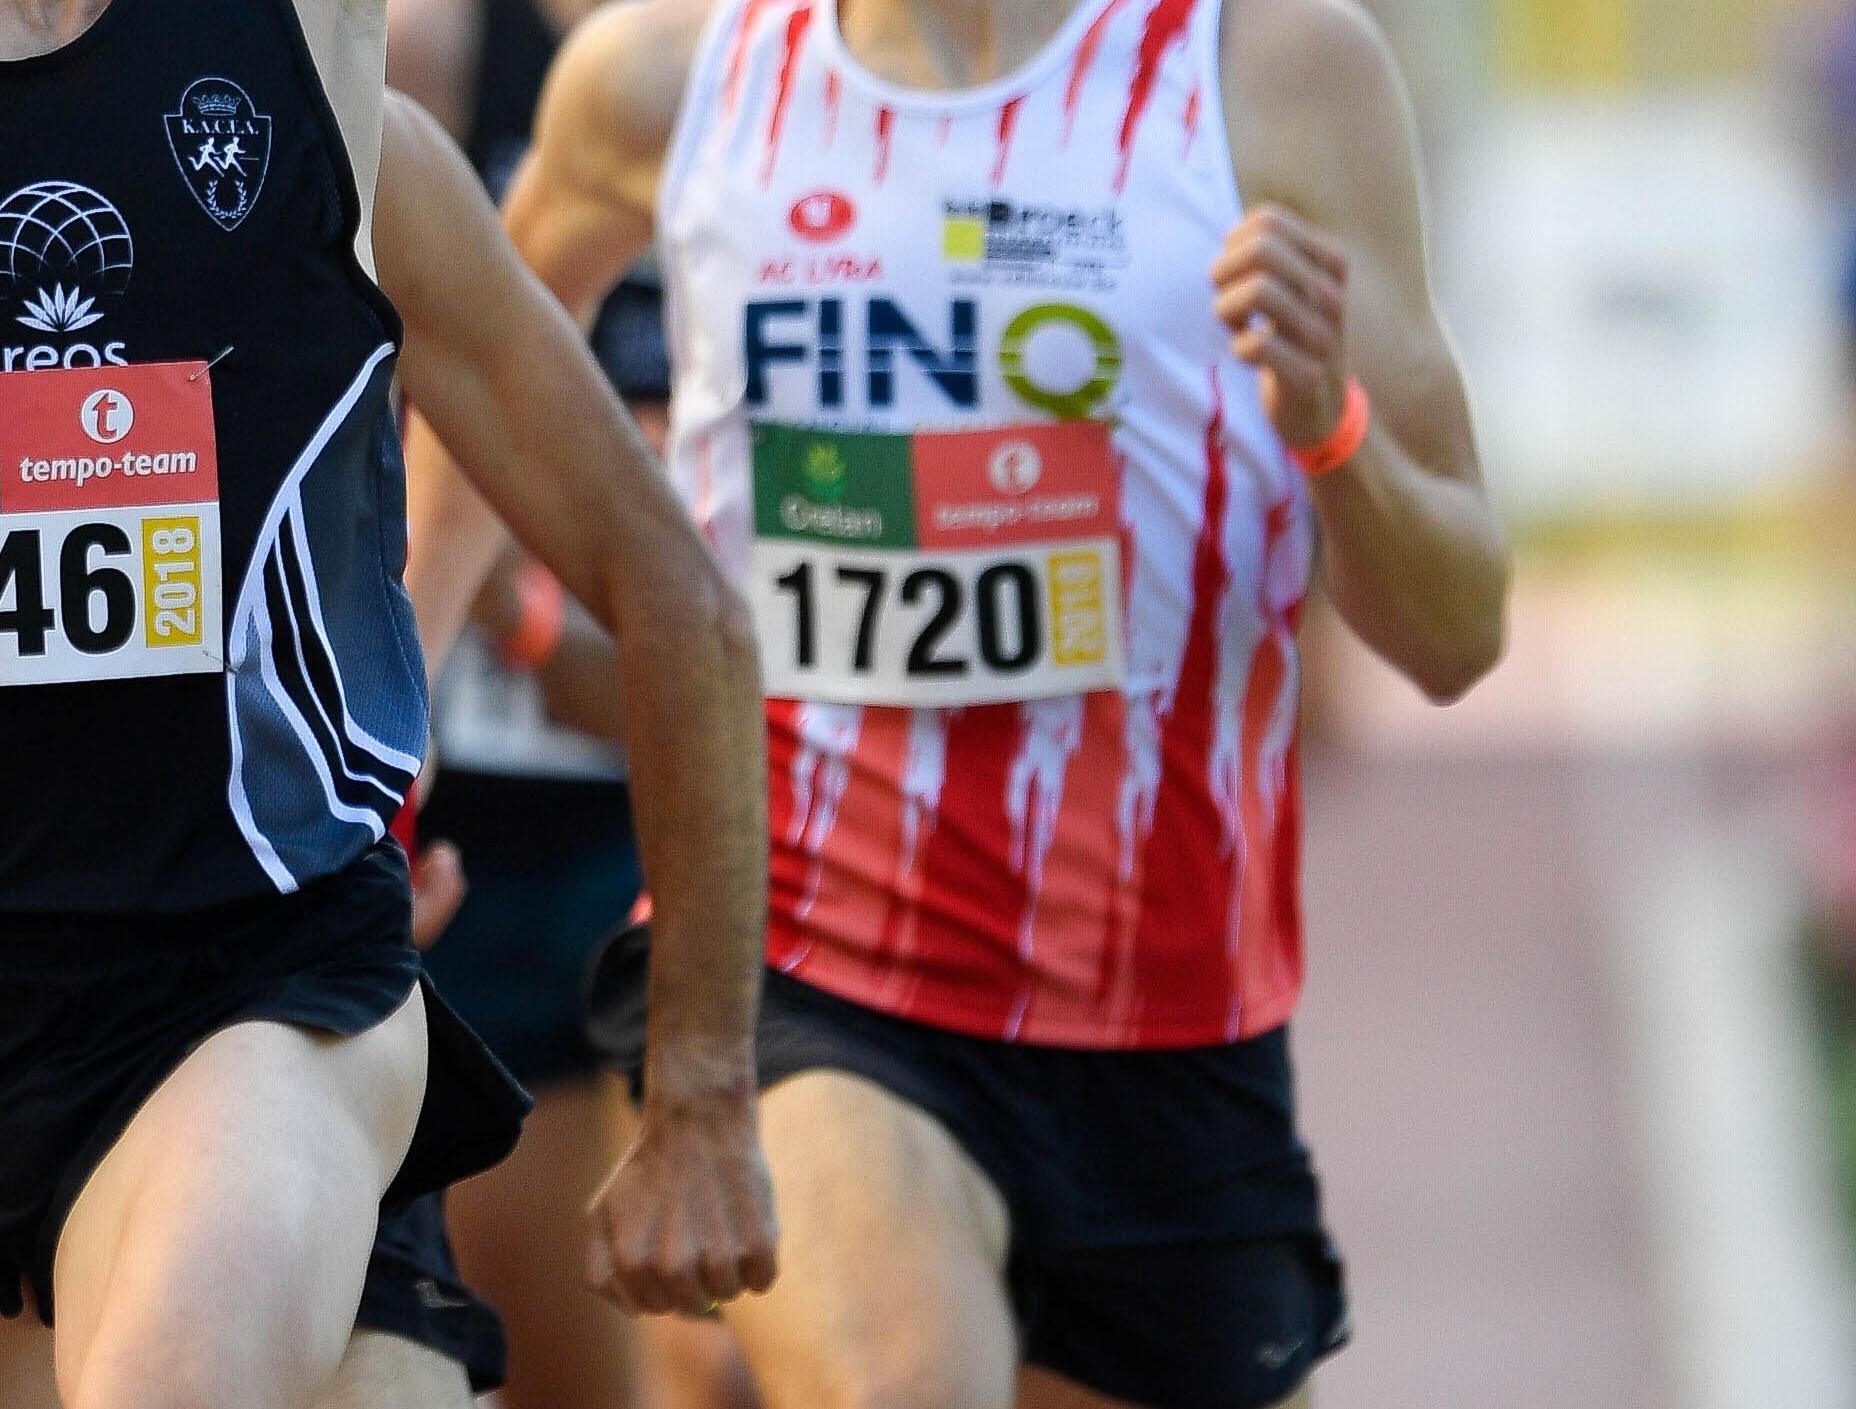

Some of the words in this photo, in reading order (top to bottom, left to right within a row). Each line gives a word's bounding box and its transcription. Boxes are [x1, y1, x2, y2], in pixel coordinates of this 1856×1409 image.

[20, 450, 197, 486] tempo-team
[152, 527, 196, 638] 2018
[775, 562, 1039, 676] 1720
